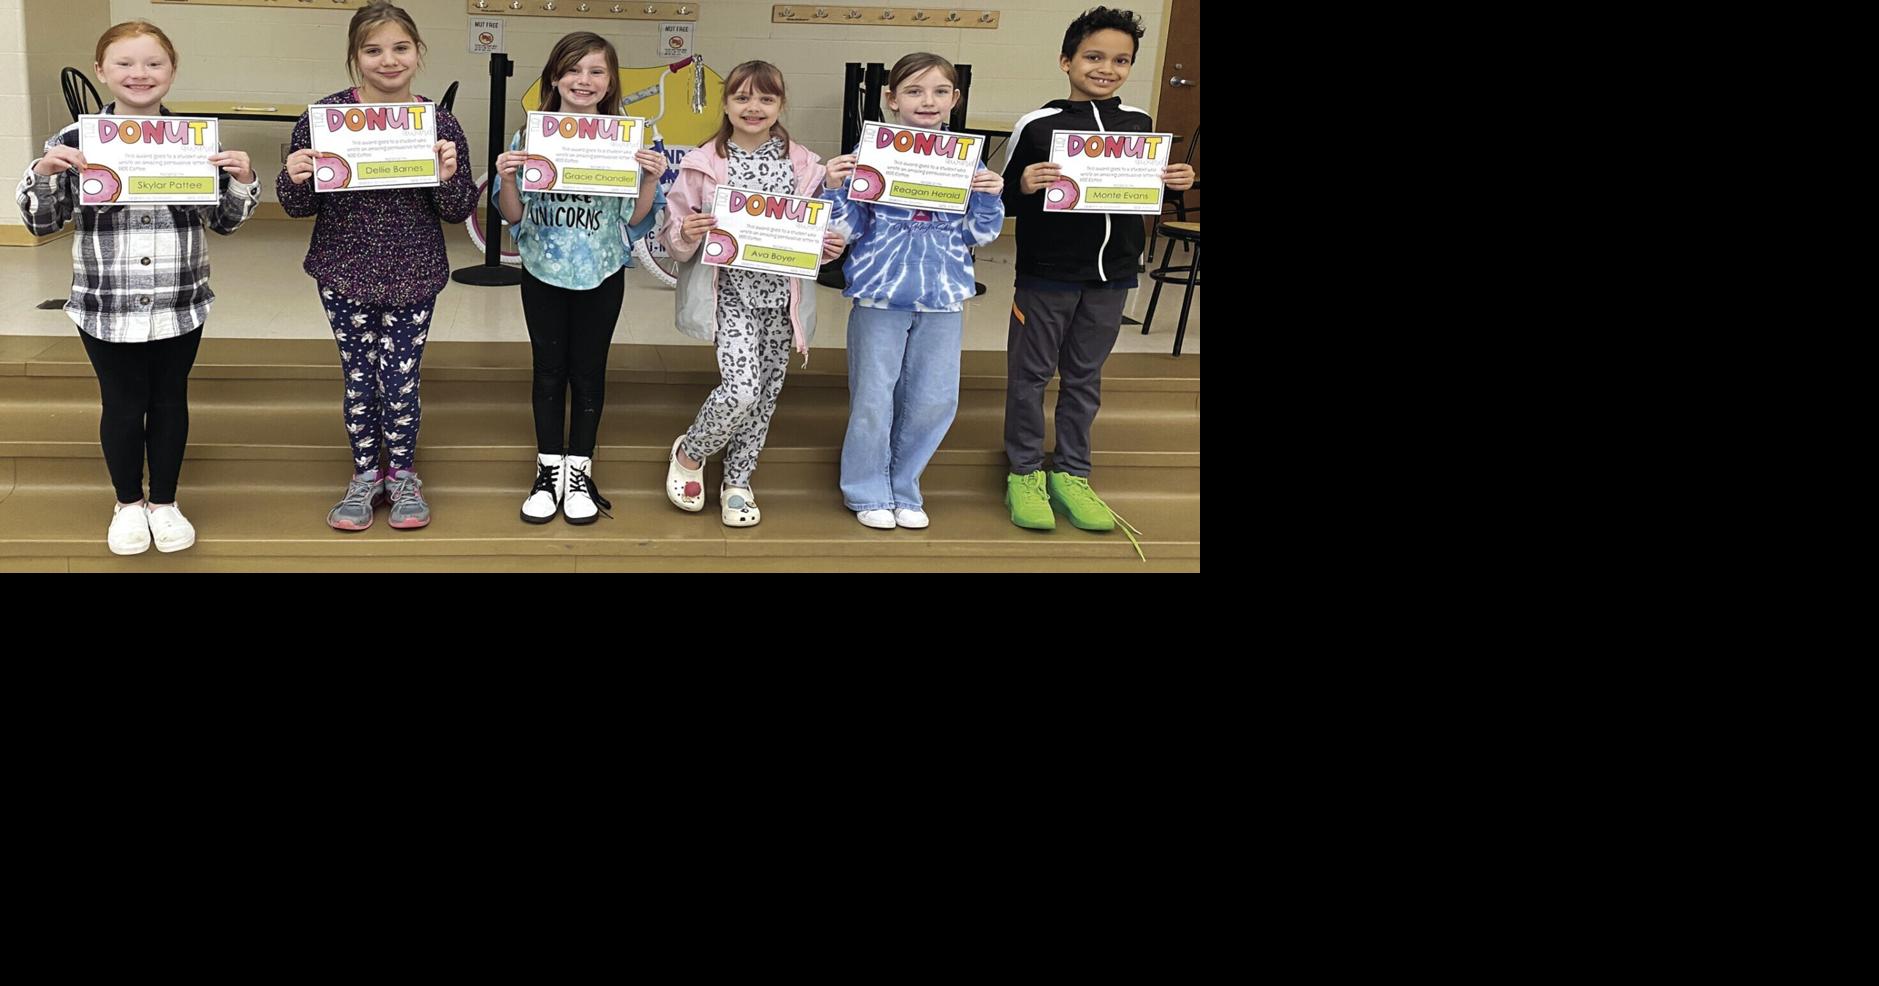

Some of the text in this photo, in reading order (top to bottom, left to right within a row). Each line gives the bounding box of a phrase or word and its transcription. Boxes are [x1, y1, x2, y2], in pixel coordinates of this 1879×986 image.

[325, 105, 426, 132] DONUT
[542, 115, 636, 142] DONUT
[98, 119, 208, 146] DONUT
[876, 127, 975, 161] DONUT
[1067, 134, 1162, 159] DONUT
[365, 165, 423, 174] Dellie Barnes
[564, 172, 633, 182] Gracie Chandler
[137, 181, 202, 190] Skylar Pattee
[894, 185, 929, 195] Reagan
[530, 206, 603, 231] UNICORNS
[729, 190, 824, 225] DONUT
[751, 250, 769, 258] Ava
